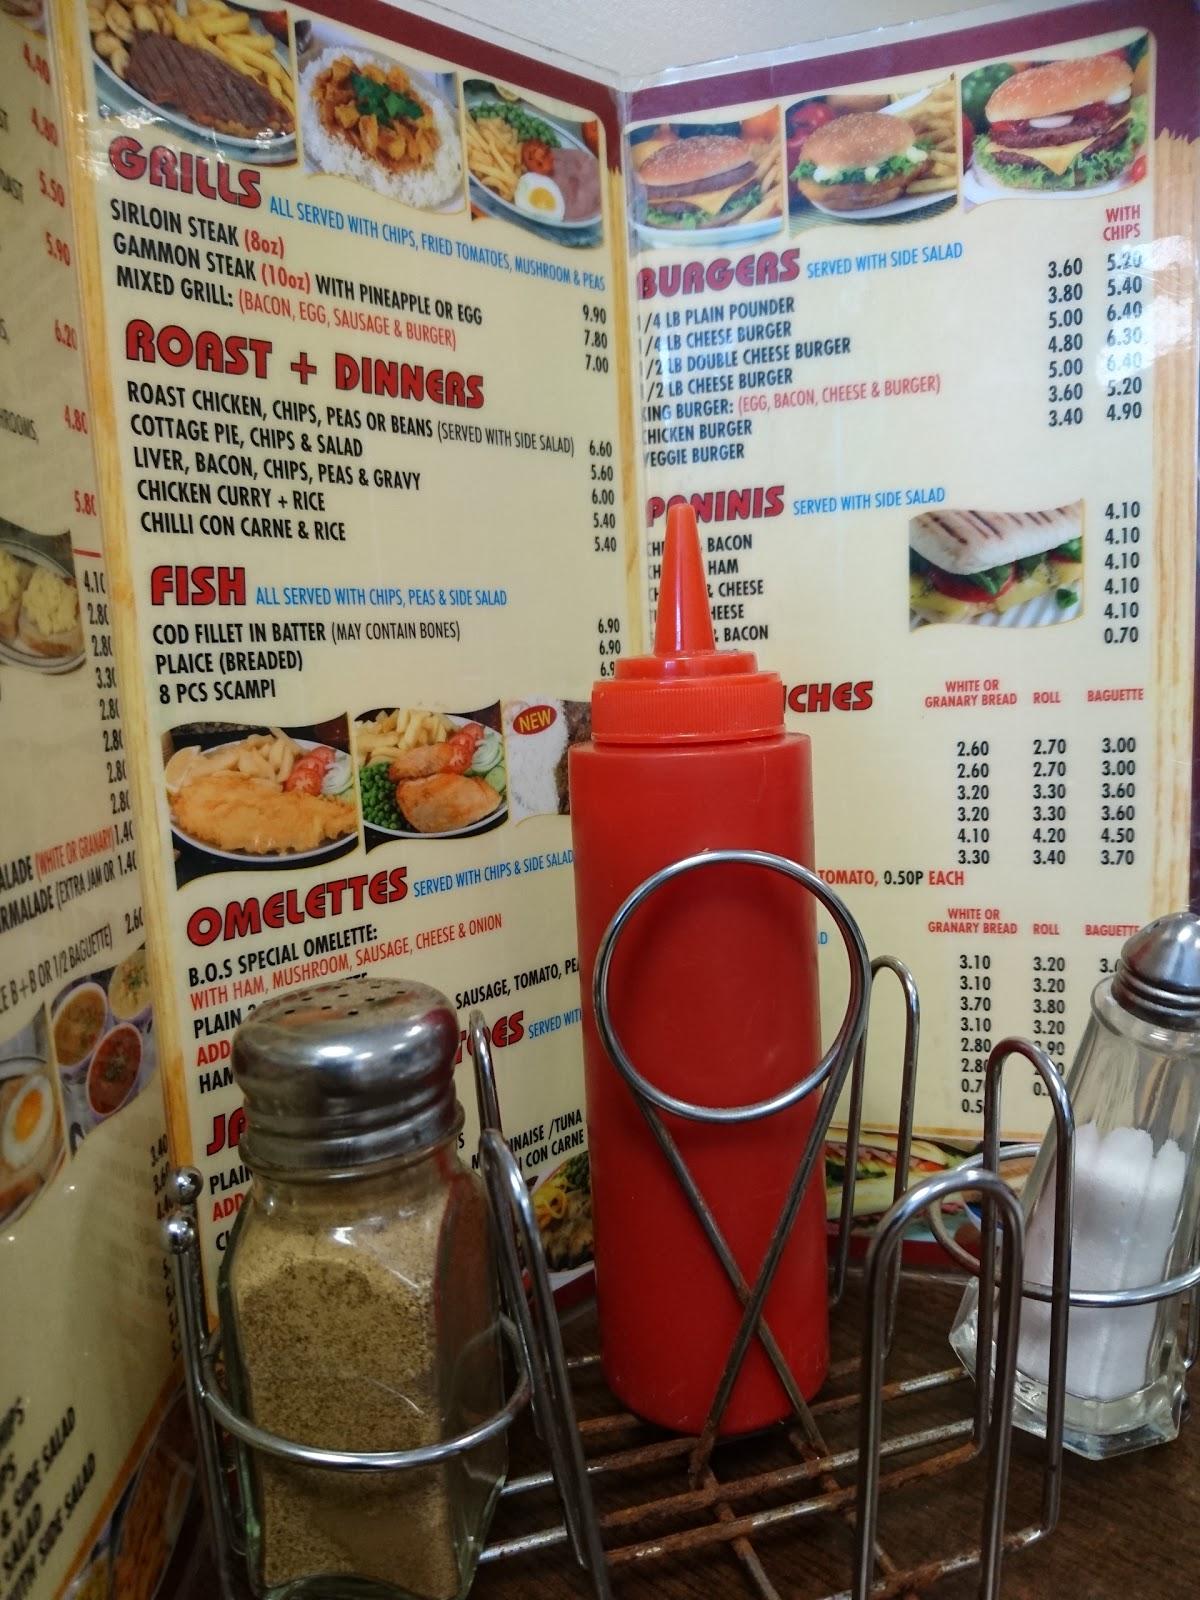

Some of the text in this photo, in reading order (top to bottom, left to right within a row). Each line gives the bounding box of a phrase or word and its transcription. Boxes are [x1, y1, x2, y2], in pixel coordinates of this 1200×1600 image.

[108, 135, 606, 291] GRILLS ALL SERVED WITH CHIPS, FRIED TOMATOES, MUSHROOM & PEAS
[1105, 204, 1141, 223] WITH
[110, 198, 285, 259] SIRLOIN STEAK (8oz)
[1103, 222, 1141, 242] CHIPS
[113, 232, 482, 325] GAMMON STEAK (10oz) WITH PINEAPPLE OR EGG
[637, 242, 963, 300] BURGERS SERVED WITH SIDE SALAD
[1048, 257, 1083, 279] 3.60
[1048, 275, 1142, 304] 3.80 5.40
[116, 265, 456, 352] MIXED GRILL: (BACON, EGG, SAUSAGE & BURGER)
[582, 304, 606, 324] 9.90
[666, 297, 795, 328] LB PLAIN POUNDER
[125, 318, 485, 409] ROAST + DINNERS
[687, 337, 851, 373] DOUBLE CHEESE BURGER
[676, 373, 941, 419] BURGER: (EGG, BACON, CHEESE & BURGER)
[127, 380, 612, 457] ROAST CHICKEN, CHIPS, PEAS OR BEANS (SERVED WITH SIDE SALAD) 6.60
[1048, 401, 1142, 428] 3.40 4.90
[134, 447, 421, 490] LIVER, BACON, CHIPS, PEAS & GRAVY
[793, 487, 945, 516] SERVED WITH SIDE SALAD
[1104, 501, 1140, 520] 4.10
[707, 533, 753, 552] BACON
[708, 558, 739, 576] HAM
[151, 565, 507, 608] FISH ALL SERVED WITH CHIPS, PEAS & SIDE SALAD
[718, 579, 764, 597] CHEESE
[152, 618, 620, 645] COD FILLET IN BATTER (MAY CONTAIN BONES) 6.90
[1104, 626, 1139, 644] 0.70
[155, 650, 302, 675] PLAICE (BREADED)
[160, 679, 276, 704] 8 PCS SCAMPI
[945, 679, 999, 693] WHITE OR
[1033, 691, 1061, 704] ROLL
[1087, 688, 1144, 702] BAGUETTE
[925, 693, 1017, 708] GRANARY BREAD
[518, 709, 551, 733] NEW
[957, 737, 1136, 756] 2.60 2.70 3.00
[818, 870, 964, 887] TOMATO, 0.50P EACH
[187, 850, 574, 947] OMELETTES SERVED WITH CHIPS & SIDE SALAD
[188, 924, 378, 987] B.O.S SPECIAL OMELETTE:
[190, 912, 502, 1011] WITH HAM, MUSHROOM, SAUSAGE, CHEESE & ONION
[959, 955, 1065, 972] 3.10 3.20
[455, 963, 562, 1010] SAUSAGE, TOMATO,
[528, 1013, 561, 1039] SERVED
[525, 1129, 584, 1167] CON CARNE
